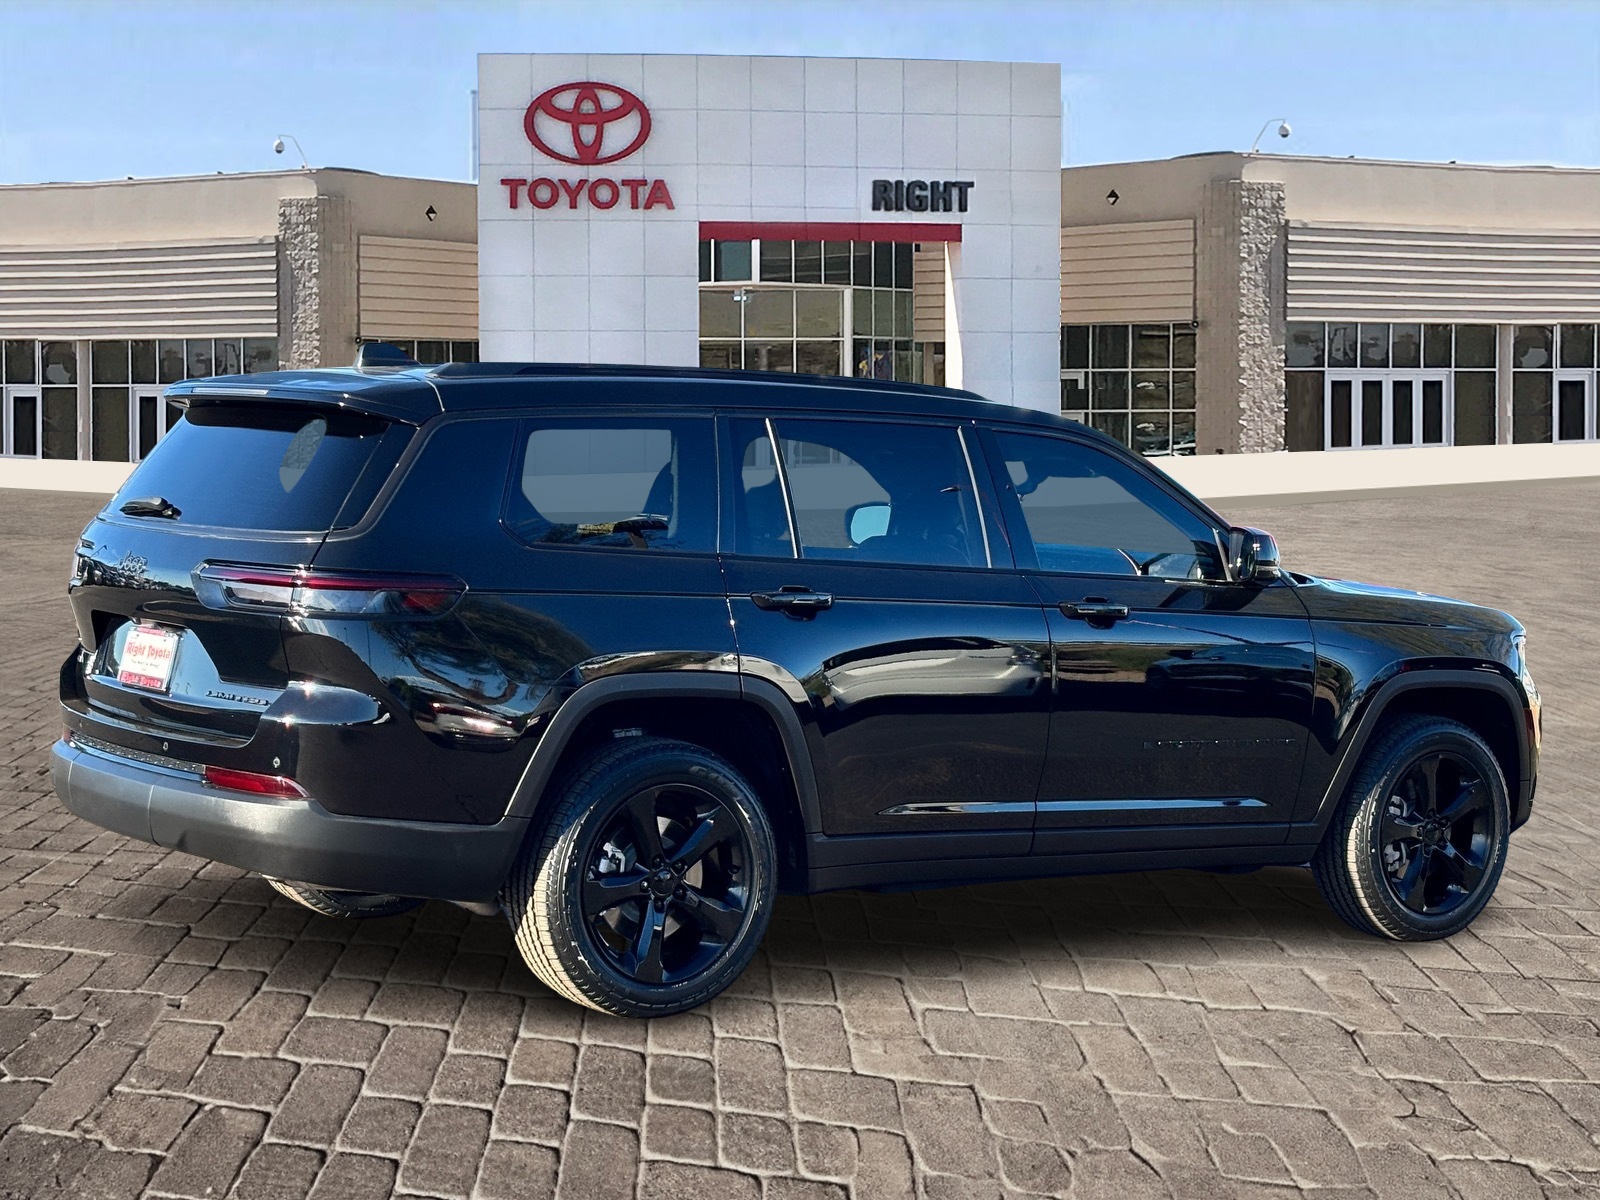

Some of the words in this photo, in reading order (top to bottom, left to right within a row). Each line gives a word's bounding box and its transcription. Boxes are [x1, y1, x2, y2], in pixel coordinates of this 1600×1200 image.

[500, 178, 675, 210] TOYOTA
[872, 179, 975, 212] RIGHT
[127, 642, 147, 657] Right
[147, 645, 171, 660] Toyota
[205, 690, 270, 706] LIMITED
